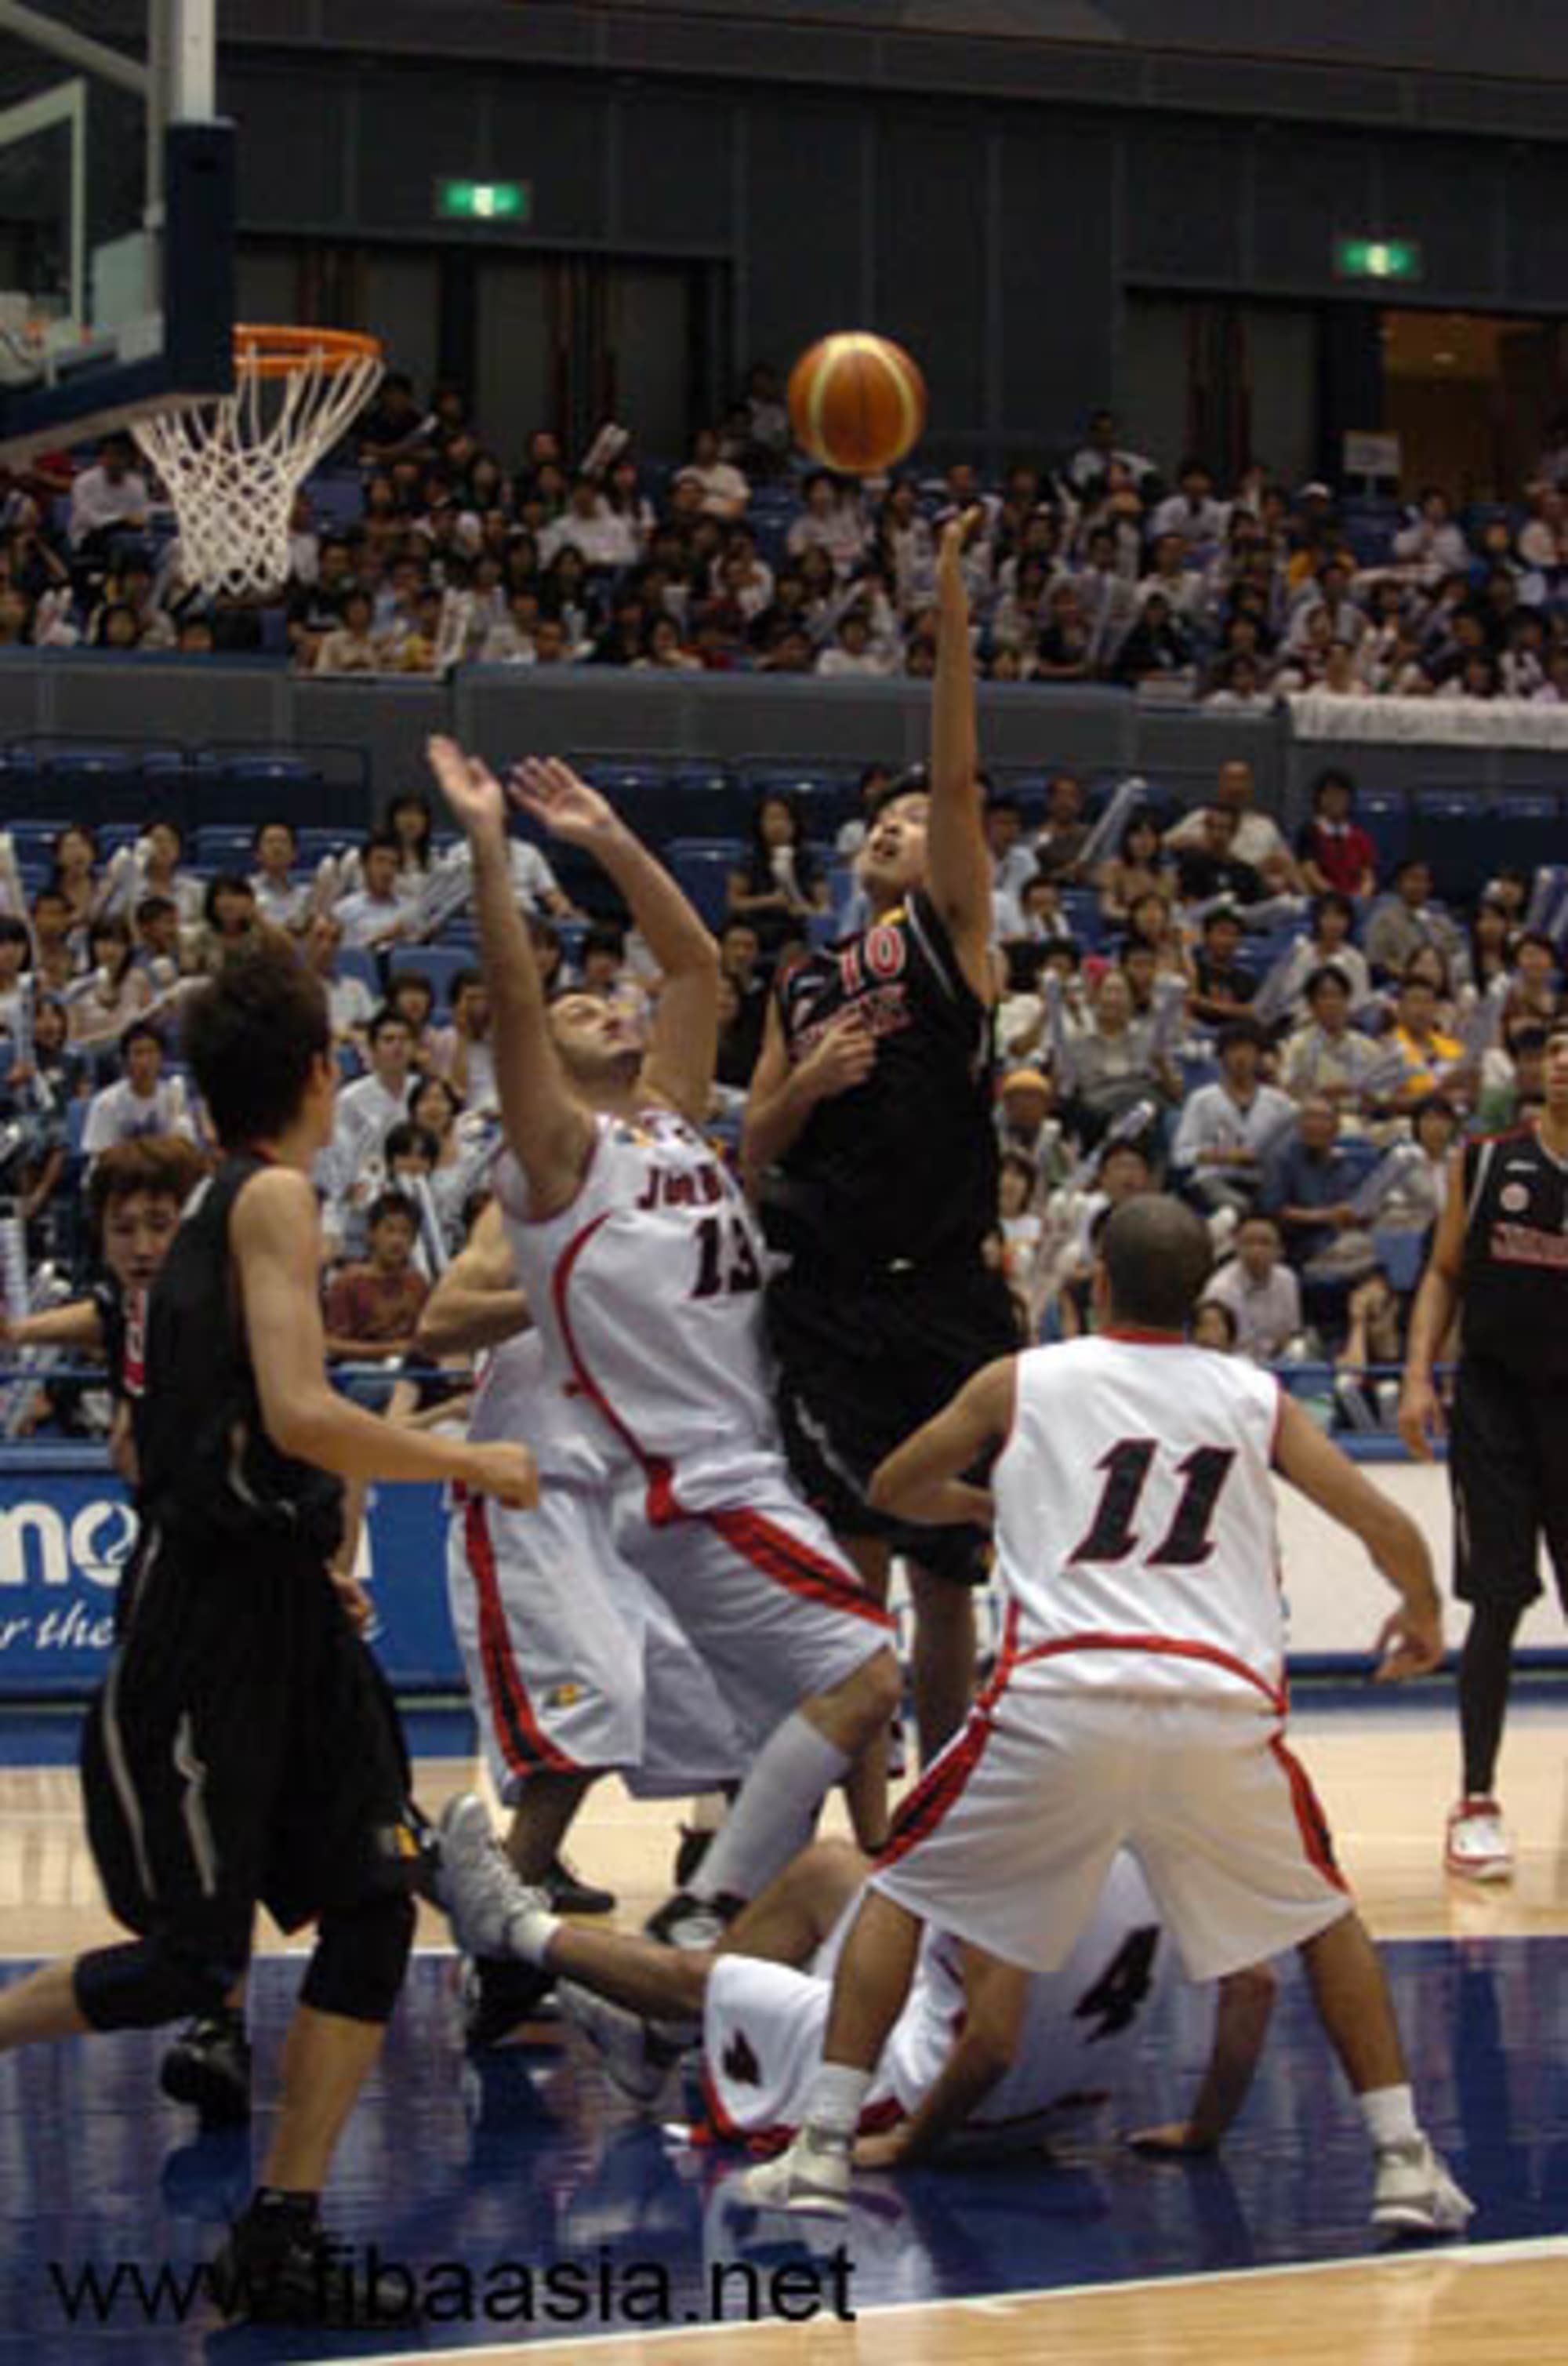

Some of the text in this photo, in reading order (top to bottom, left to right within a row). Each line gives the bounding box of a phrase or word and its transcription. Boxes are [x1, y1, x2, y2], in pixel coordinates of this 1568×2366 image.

[837, 925, 907, 995] 10
[689, 1216, 761, 1299] 13
[1066, 1437, 1236, 1566] 11
[1072, 1924, 1160, 2044] 4
